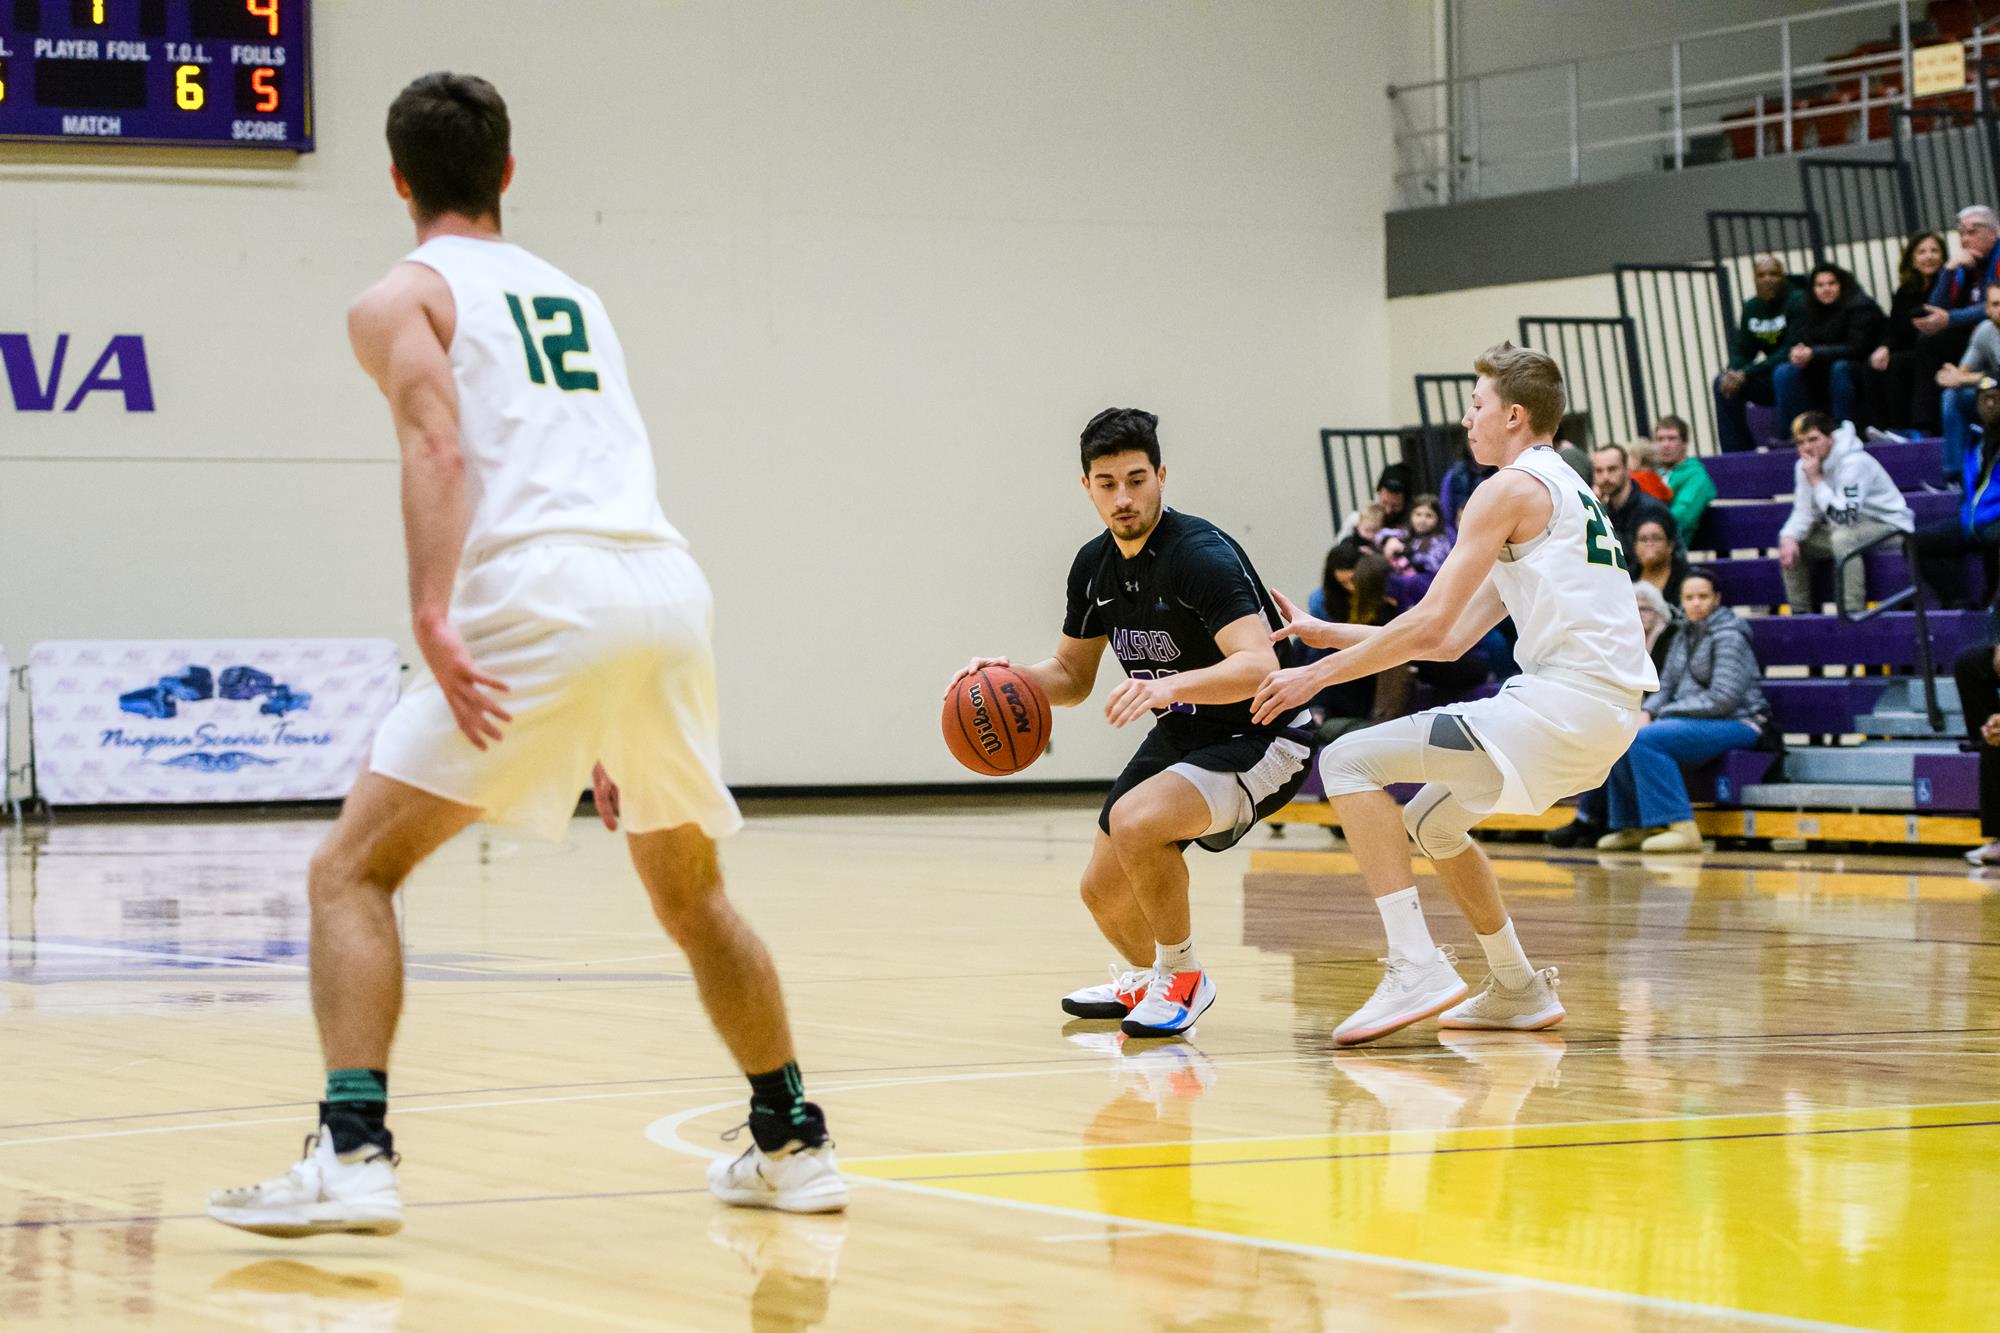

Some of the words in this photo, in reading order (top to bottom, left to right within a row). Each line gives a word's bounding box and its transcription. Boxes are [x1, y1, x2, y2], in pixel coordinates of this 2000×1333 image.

[246, 0, 279, 36] 4
[34, 38, 99, 59] PLAYER
[106, 41, 152, 61] FOUL
[164, 42, 213, 63] T.O.L.
[231, 45, 287, 65] FOULS
[176, 65, 204, 110] 6
[251, 67, 279, 112] 5
[62, 116, 121, 135] MATCH
[231, 120, 288, 141] SCORE
[504, 291, 601, 392] 12
[1113, 626, 1181, 662] ALFRED
[968, 682, 1003, 756] Wilson
[1000, 682, 1032, 734] NCAA
[100, 728, 193, 757] Niagara
[195, 723, 269, 749] Scenic
[271, 720, 333, 746] Tours
